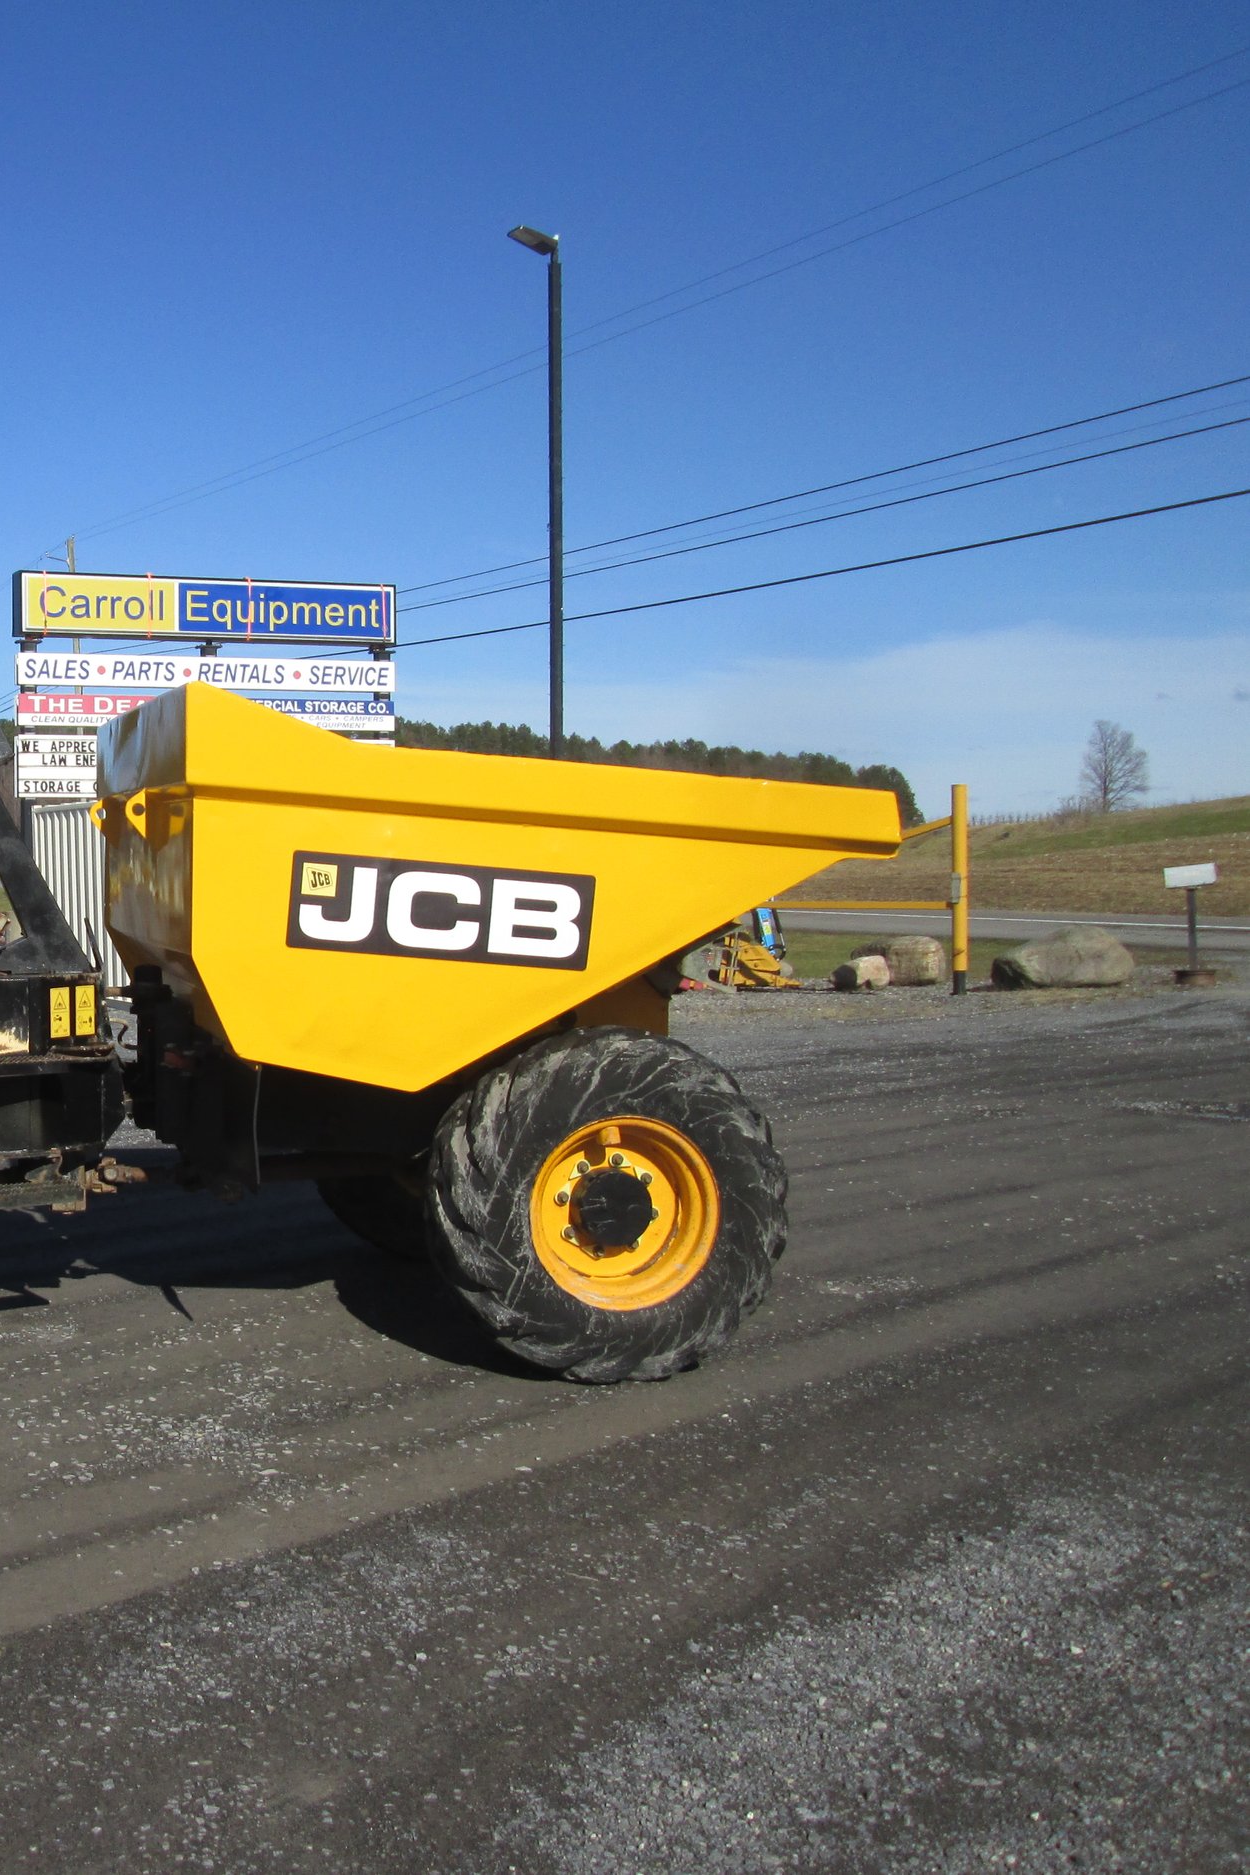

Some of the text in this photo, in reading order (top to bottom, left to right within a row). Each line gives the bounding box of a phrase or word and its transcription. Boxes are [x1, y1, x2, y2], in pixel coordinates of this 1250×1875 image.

[39, 586, 380, 632] Carroll Equipment
[24, 658, 390, 687] SALES PARTS RENTALS SERVICE
[28, 695, 84, 713] THE
[304, 700, 365, 713] STORAGE
[367, 702, 390, 714] CO.
[31, 714, 66, 723] CLEAN
[308, 714, 385, 723] CARS CAMPERS
[316, 721, 367, 729] EQUIPMENT
[21, 740, 40, 753] WE
[42, 754, 67, 766] LAW
[23, 780, 81, 793] STORAGE
[311, 870, 331, 888] JCB
[299, 866, 582, 959] JCB
